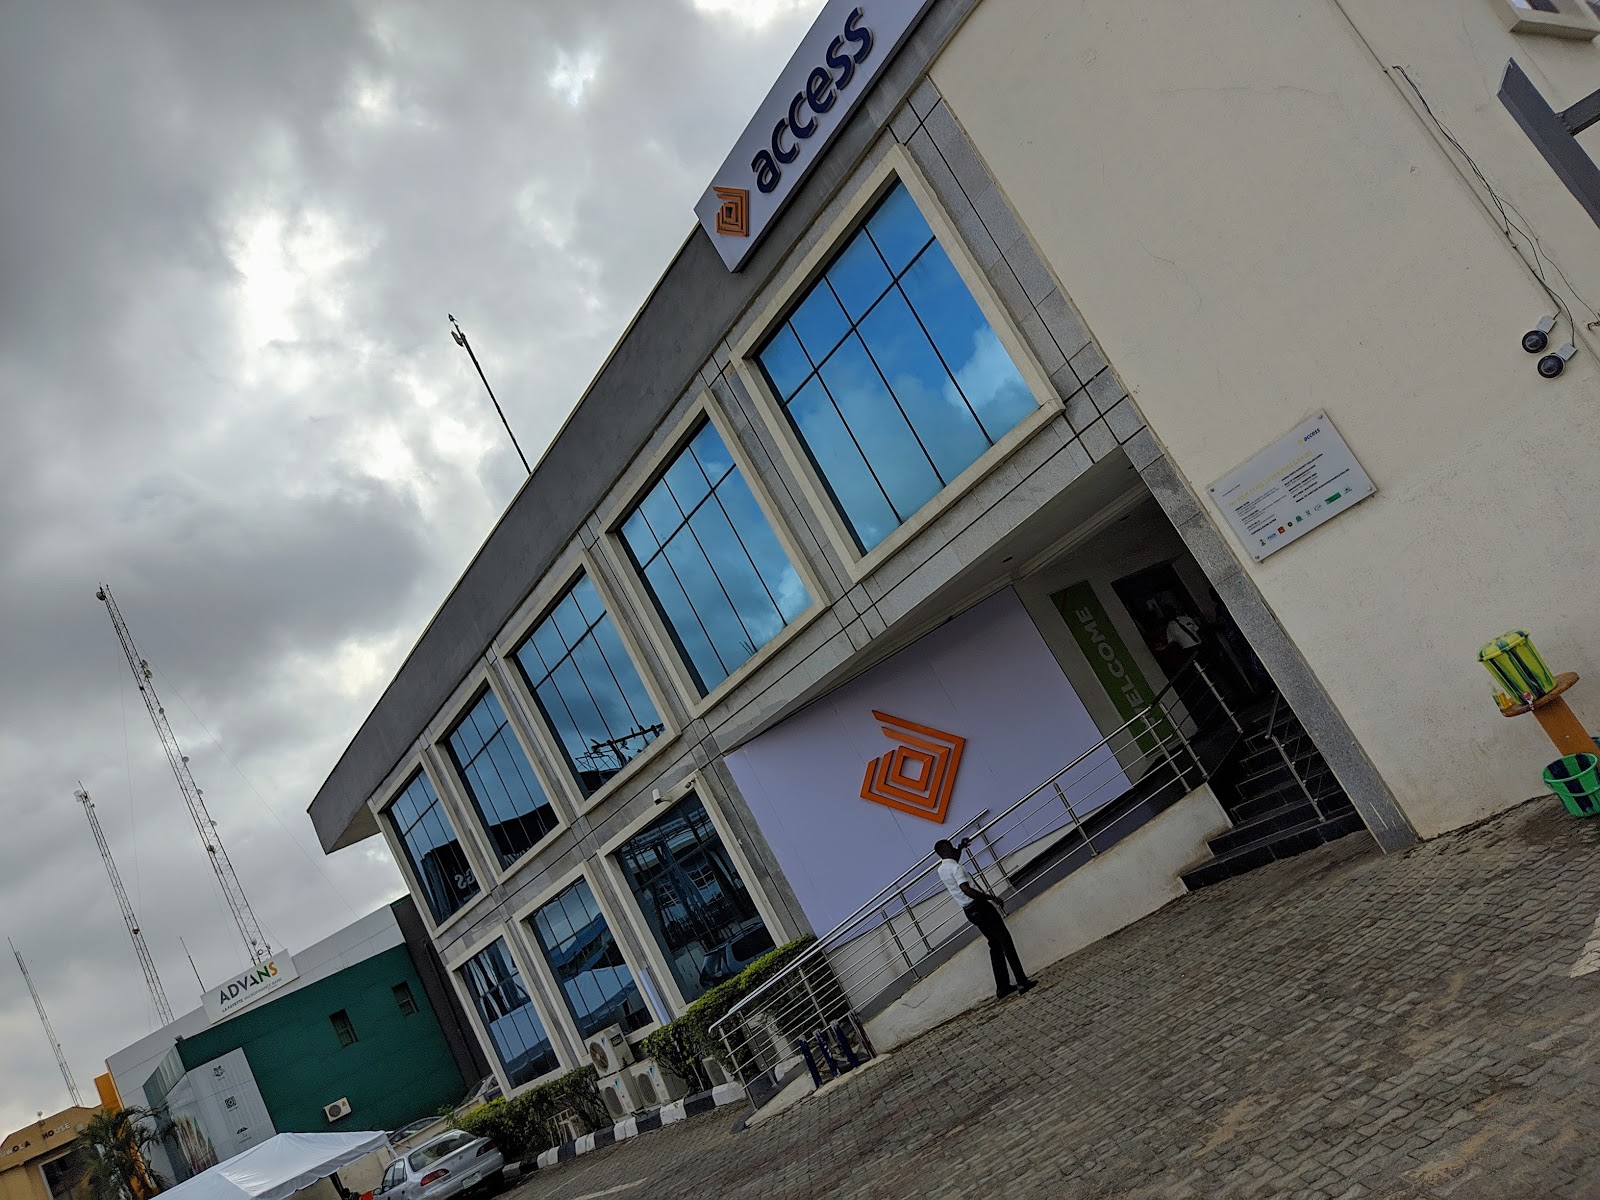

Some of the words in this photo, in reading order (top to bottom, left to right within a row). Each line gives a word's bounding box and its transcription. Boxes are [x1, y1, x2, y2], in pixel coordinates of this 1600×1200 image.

[751, 7, 874, 194] access
[1304, 428, 1320, 442] access
[220, 961, 278, 1005] ADVANS
[42, 1122, 72, 1140] HOUSE
